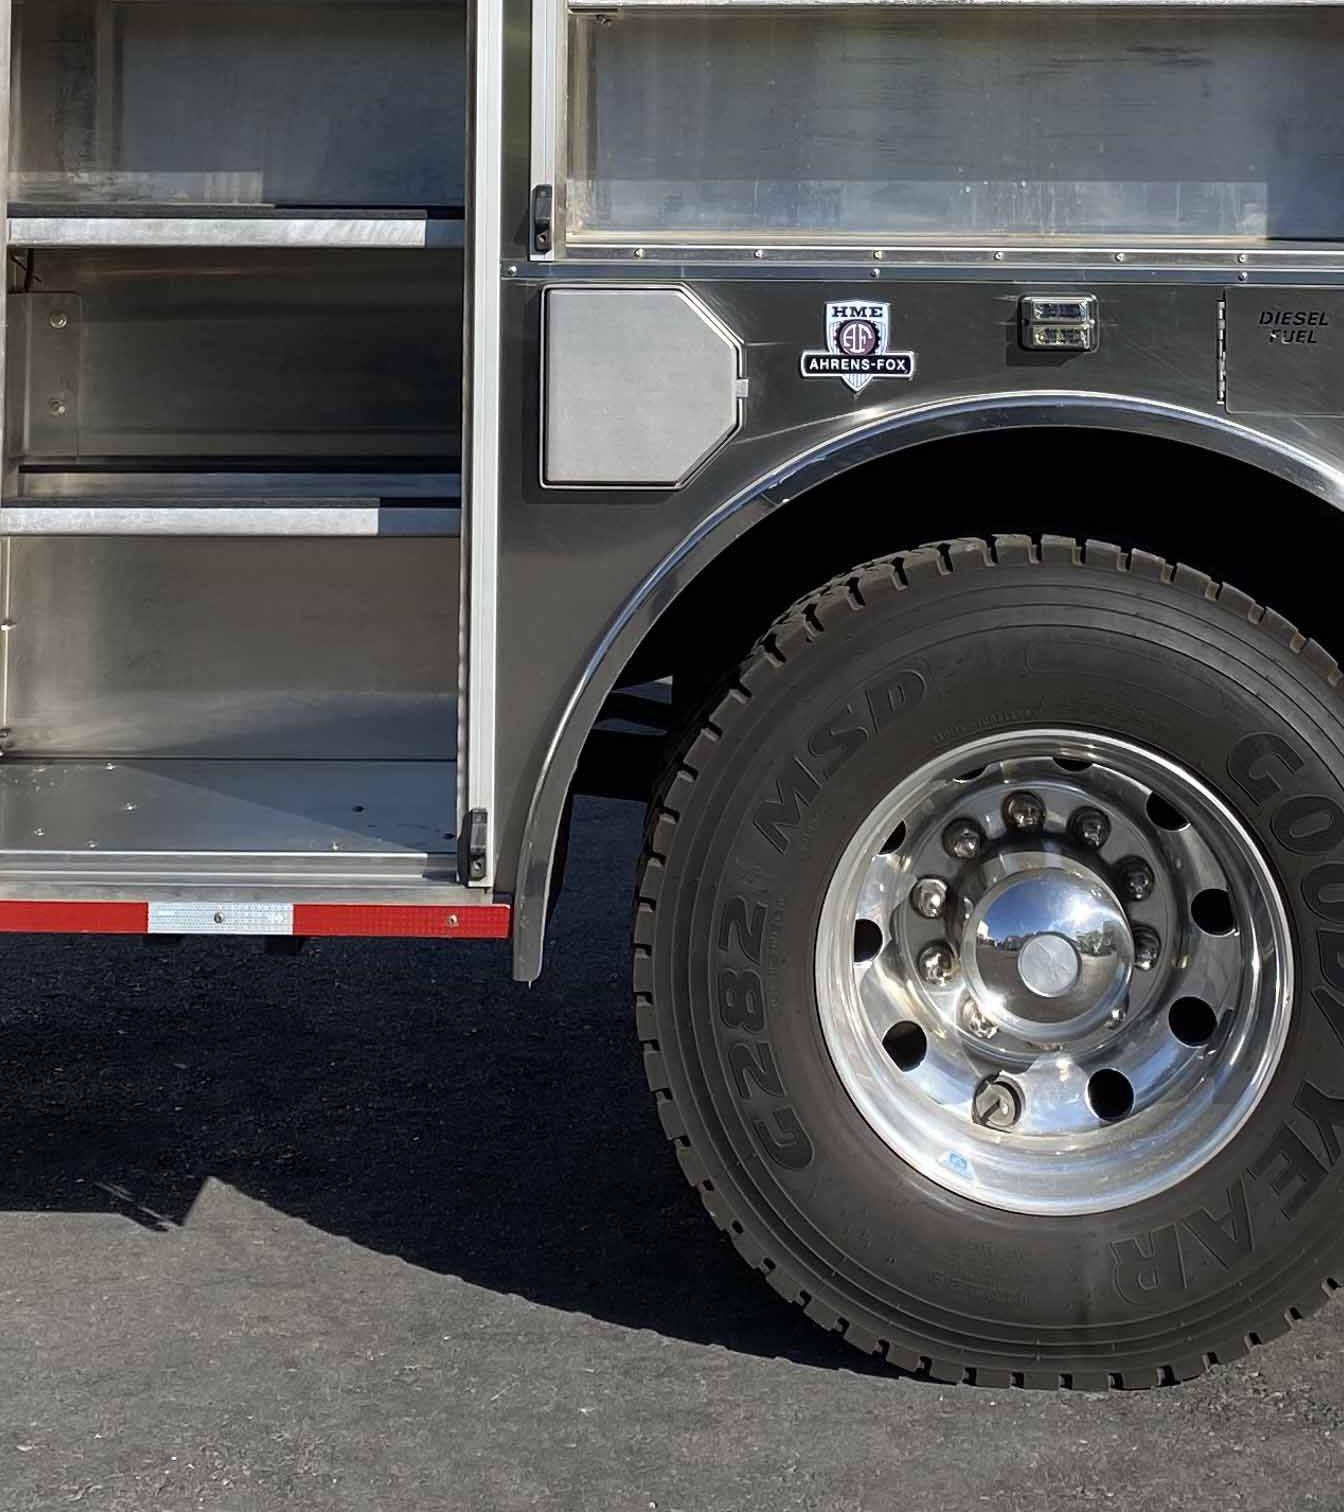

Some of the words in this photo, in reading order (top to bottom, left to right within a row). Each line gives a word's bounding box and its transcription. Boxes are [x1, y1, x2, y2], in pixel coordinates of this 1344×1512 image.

[831, 306, 883, 318] HME
[1259, 311, 1329, 326] DIESEL
[1269, 329, 1318, 344] FUEL
[809, 358, 906, 370] AHRENS-FOX
[752, 668, 927, 855] MSD
[719, 894, 816, 1170] G282
